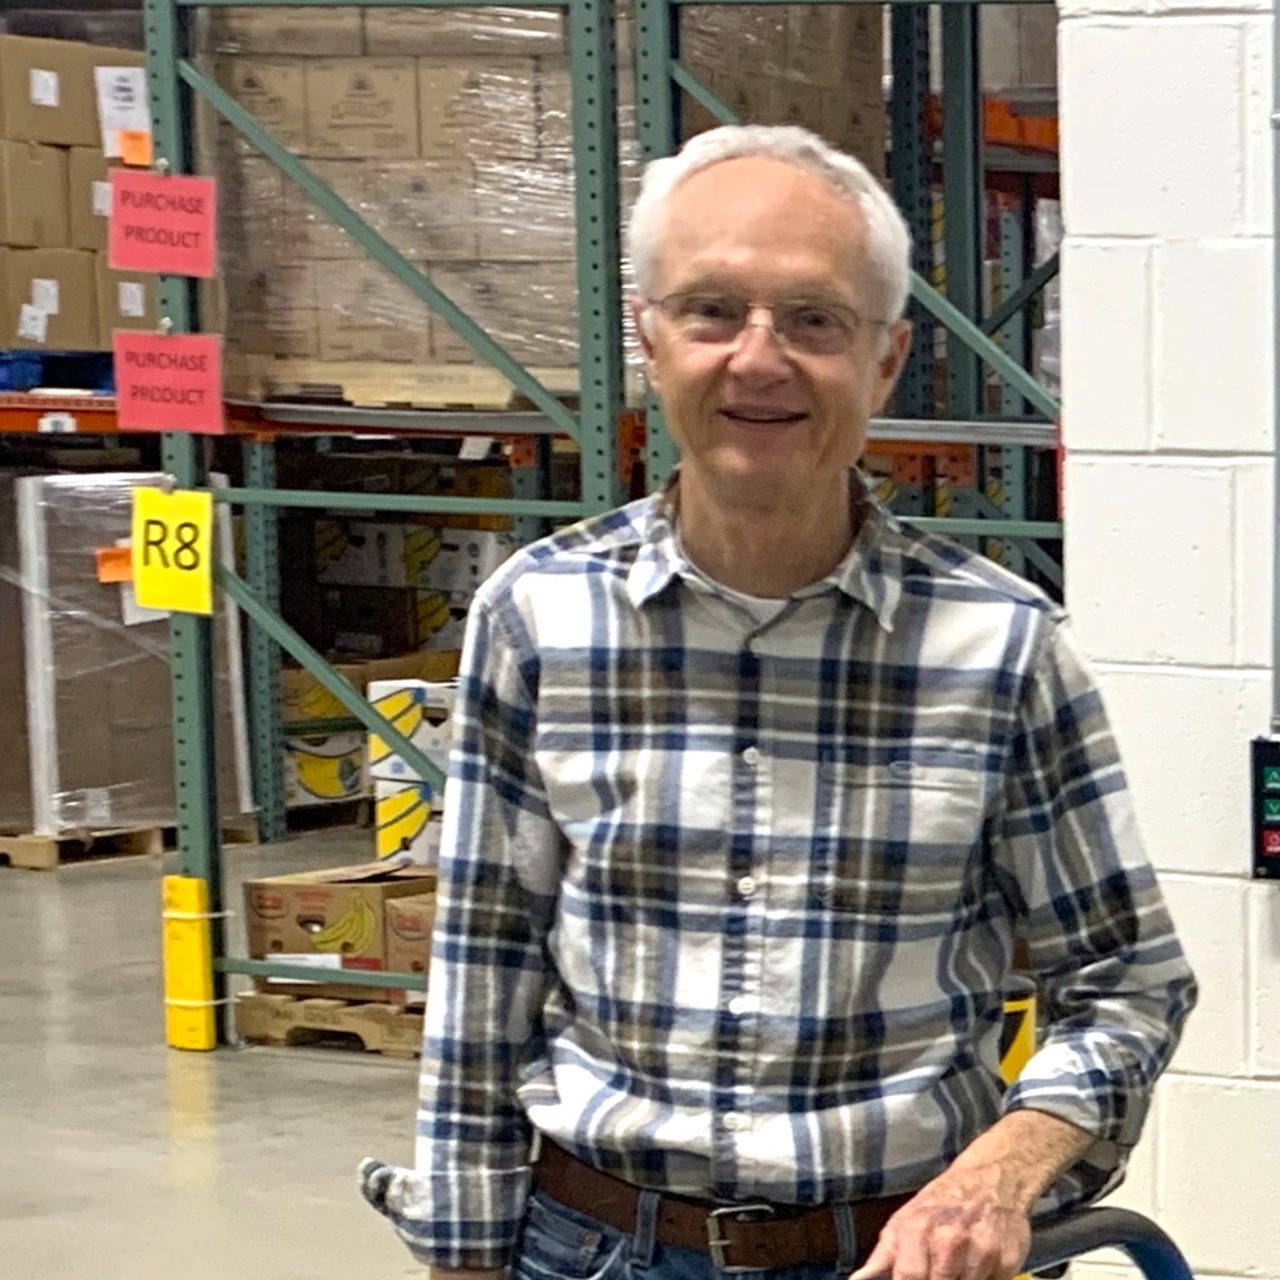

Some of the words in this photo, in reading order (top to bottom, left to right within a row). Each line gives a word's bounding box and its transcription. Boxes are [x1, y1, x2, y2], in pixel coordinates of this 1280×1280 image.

[119, 190, 206, 215] PURCHASE
[123, 225, 203, 248] PRODUCT
[125, 351, 208, 372] PURCHASE
[130, 384, 205, 405] PRODUCT
[143, 519, 201, 571] R8
